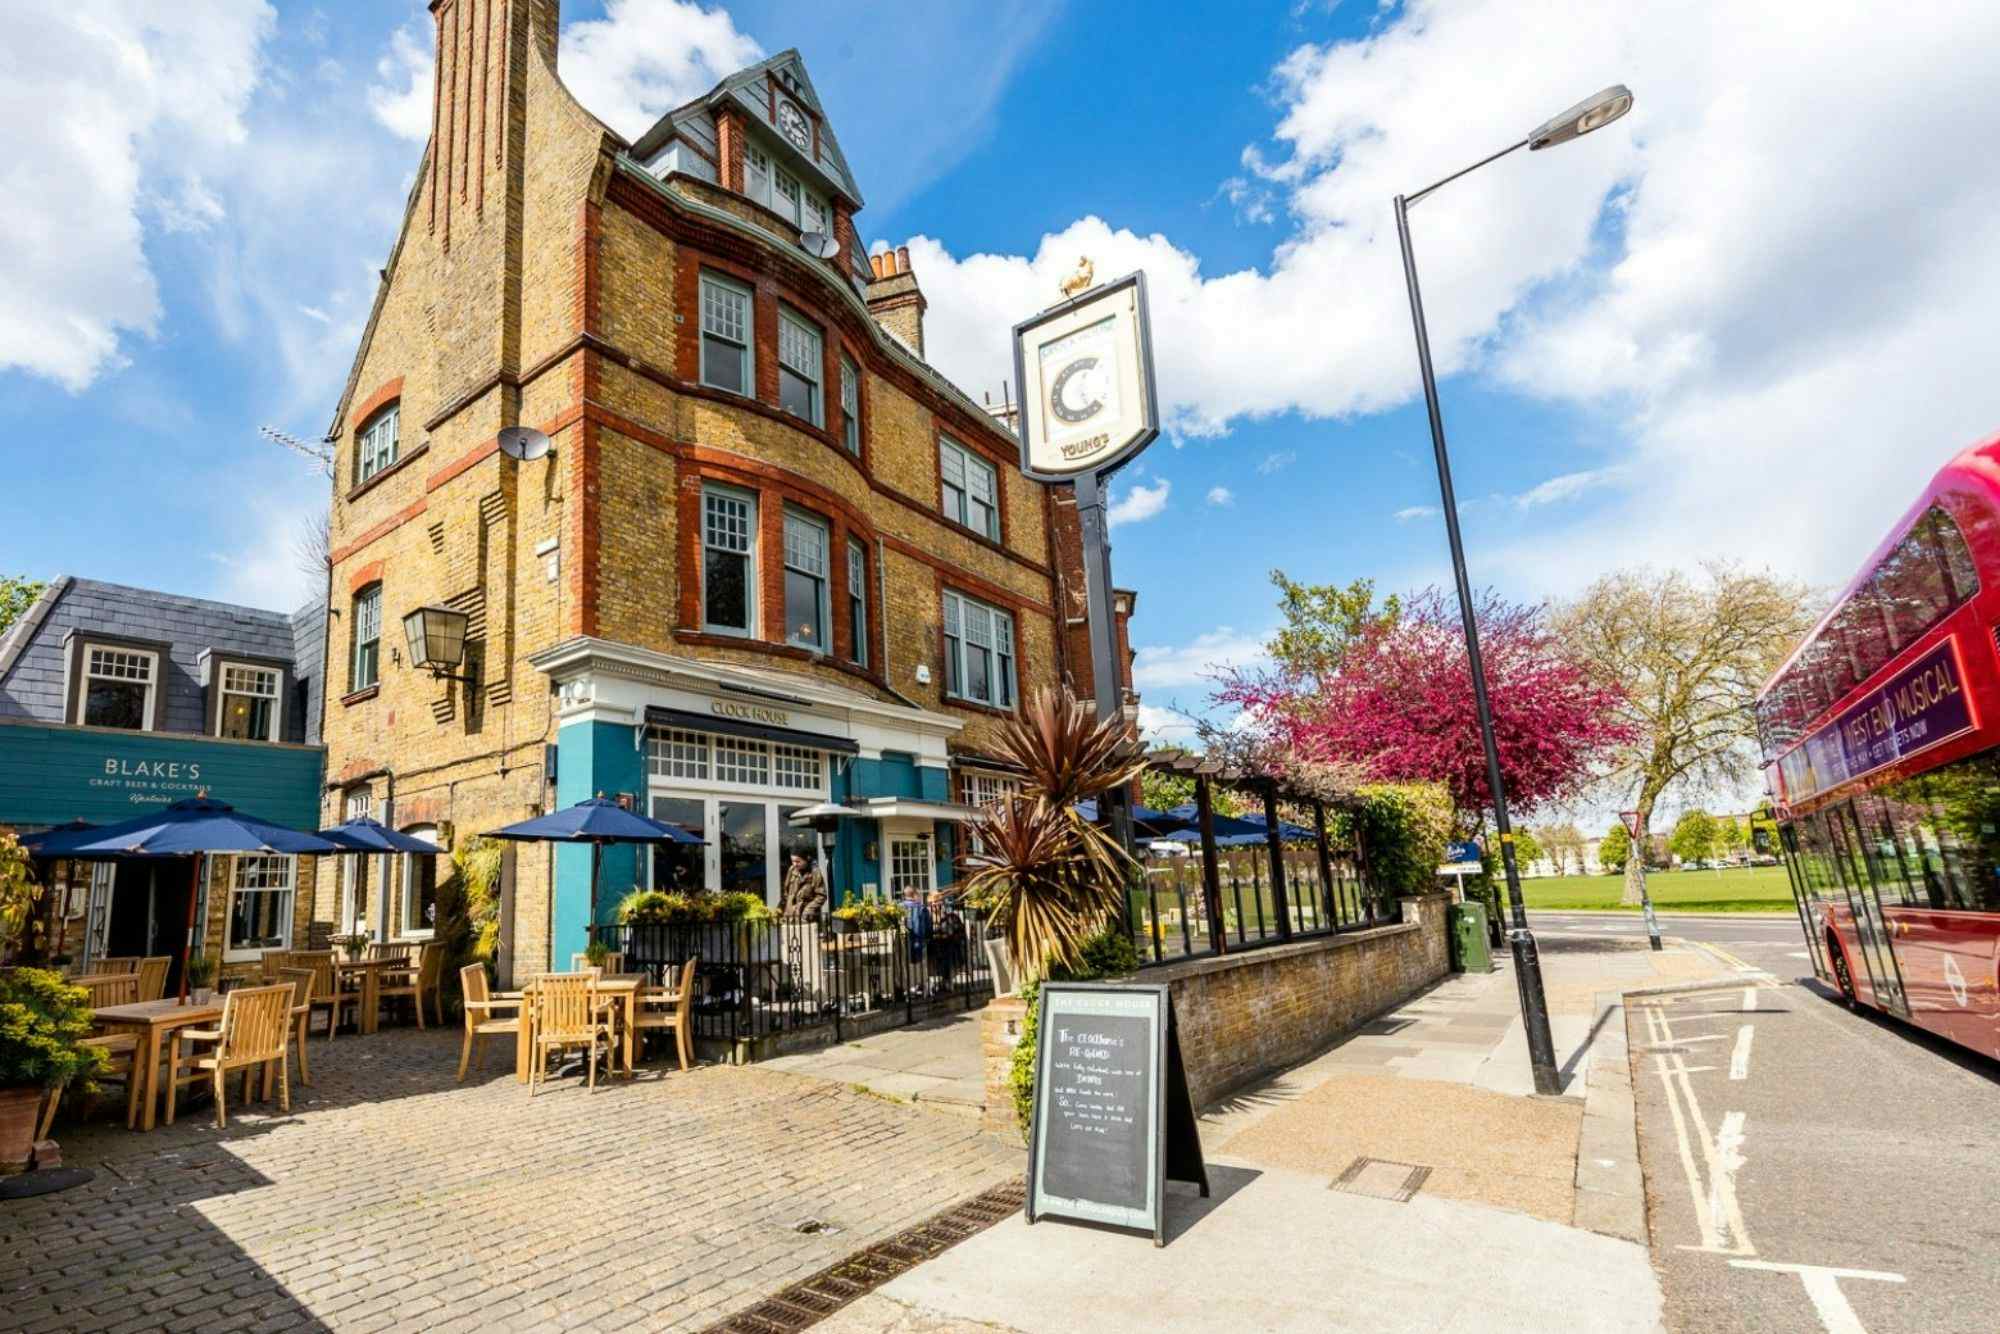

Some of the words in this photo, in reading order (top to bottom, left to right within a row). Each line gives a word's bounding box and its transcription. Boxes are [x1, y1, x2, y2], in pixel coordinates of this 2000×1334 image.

[1060, 433, 1110, 457] YOUNG'S
[711, 701, 750, 719] CLOCK
[752, 707, 789, 725] HOUSE
[1843, 712, 1872, 754] WEST
[1870, 697, 1897, 736] END
[1895, 659, 1960, 721] MUSICAL
[104, 758, 201, 780] BLAKE'S
[89, 778, 121, 787] CRAFT
[125, 780, 148, 788] BEER
[150, 781, 157, 789] &
[160, 781, 213, 791] COCKTAILS
